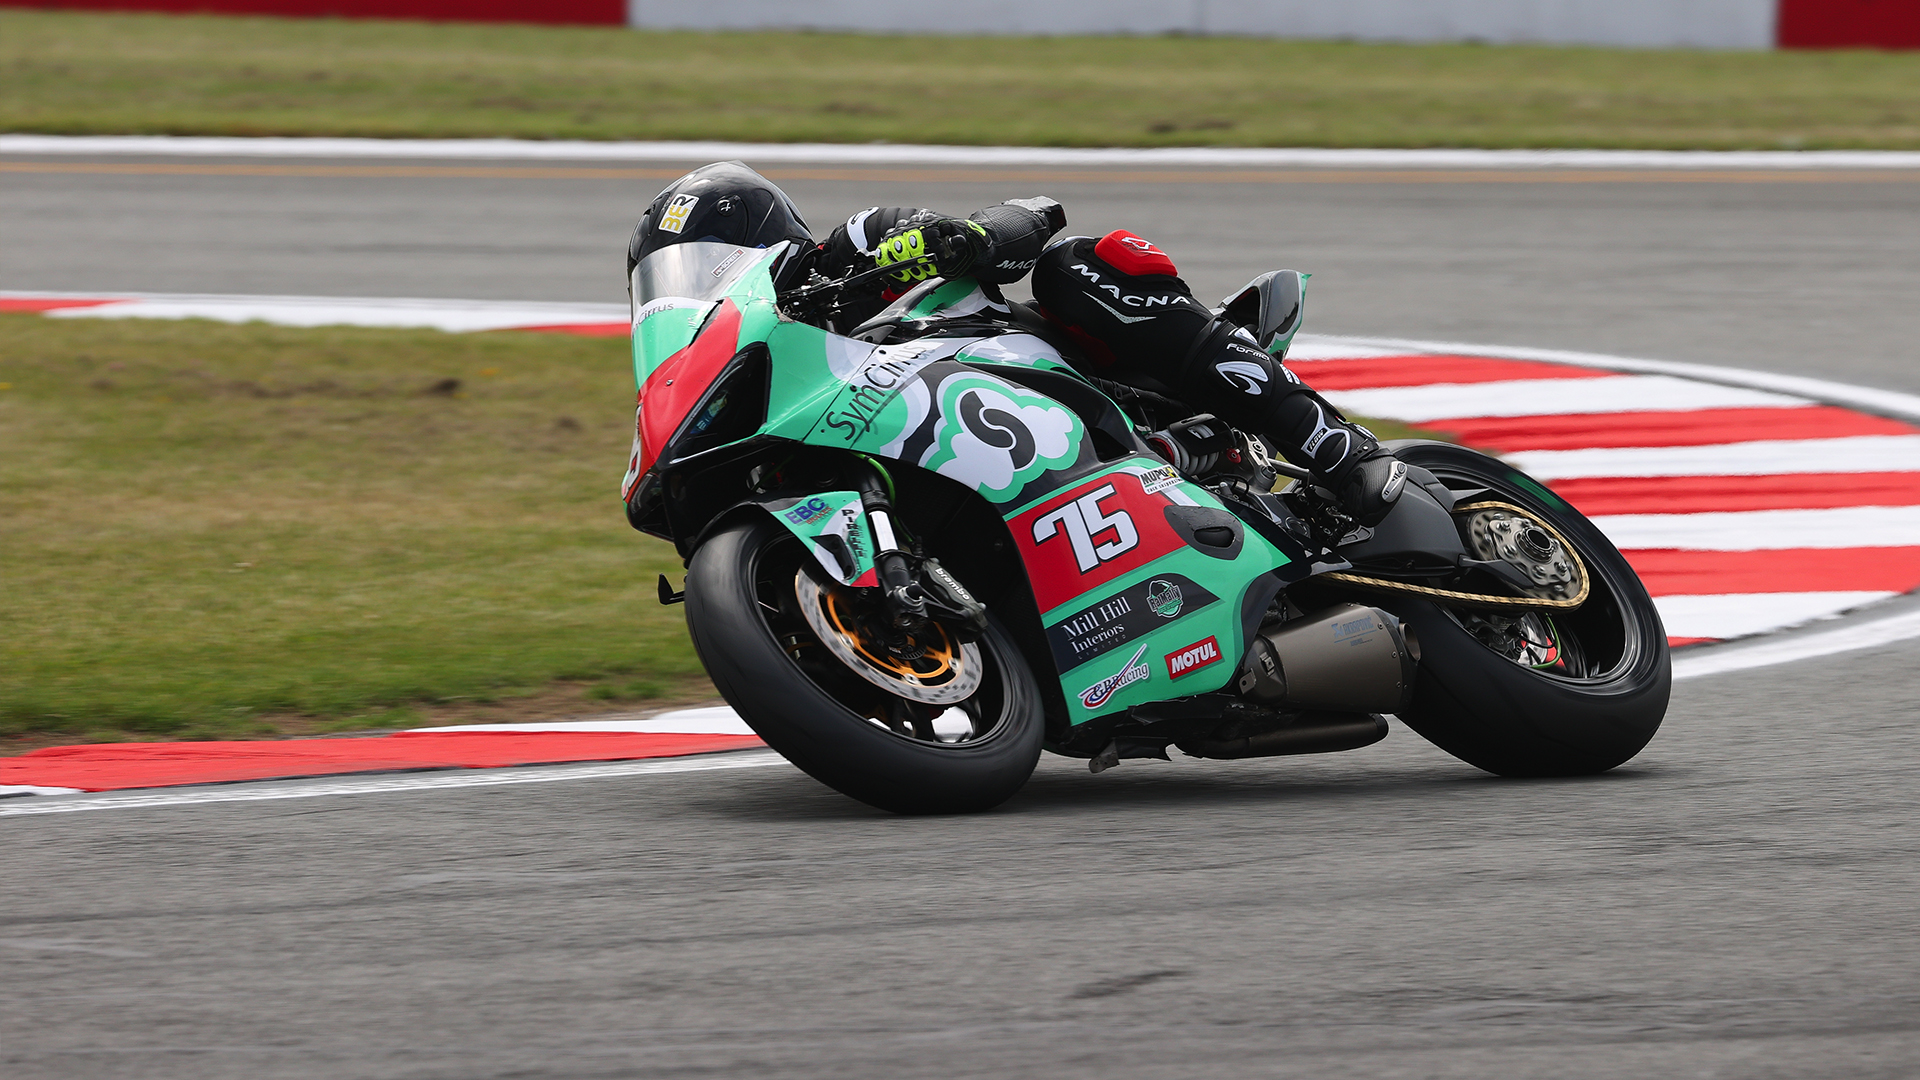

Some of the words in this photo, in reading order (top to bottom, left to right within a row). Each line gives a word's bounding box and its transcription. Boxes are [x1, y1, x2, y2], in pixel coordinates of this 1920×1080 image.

[996, 259, 1036, 269] MAC
[1070, 264, 1191, 307] MACNA
[635, 303, 674, 329] Cirrus
[784, 497, 826, 524] EBC
[805, 506, 833, 525] BRAKES
[1031, 481, 1140, 575] 75
[935, 567, 970, 600] brembo
[1061, 612, 1100, 641] Mill
[1098, 596, 1132, 623] Hill
[1071, 624, 1125, 654] Interiors
[1171, 642, 1217, 674] MOTUL
